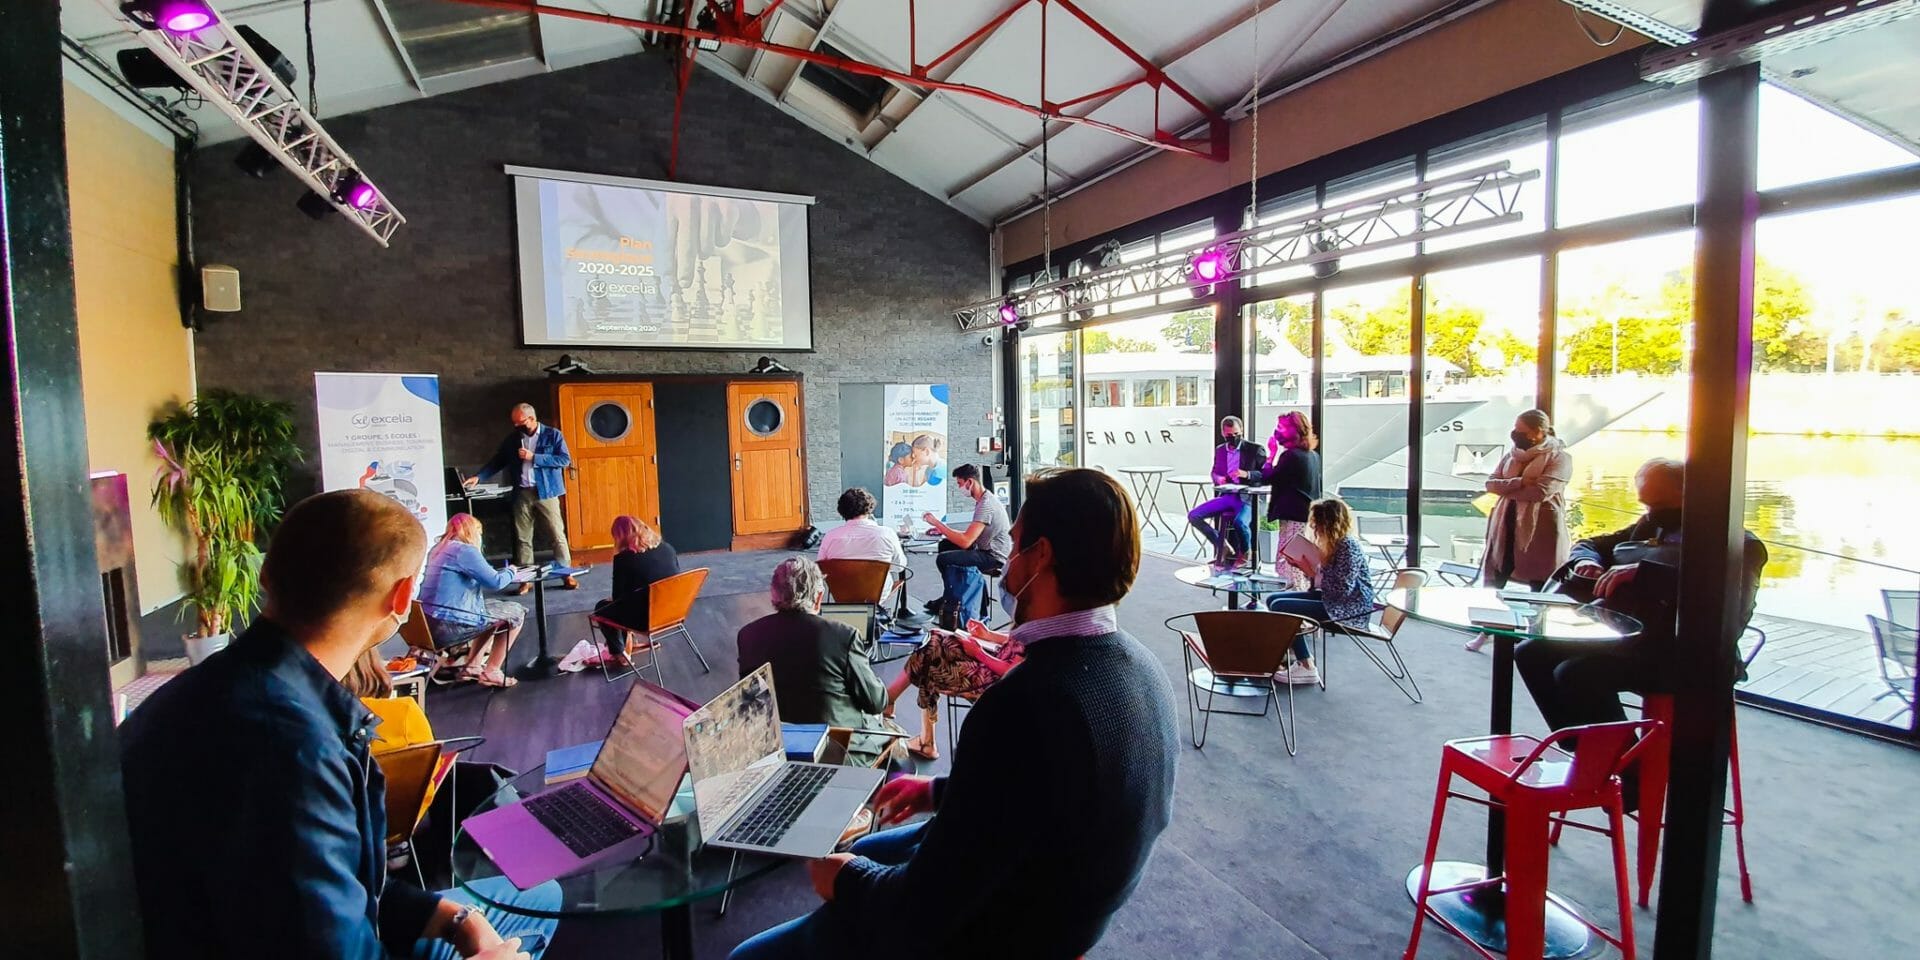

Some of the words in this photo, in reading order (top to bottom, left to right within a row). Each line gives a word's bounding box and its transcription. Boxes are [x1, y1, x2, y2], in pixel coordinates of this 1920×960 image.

[620, 237, 653, 249] Plan
[578, 262, 654, 276] 2020-2025
[609, 282, 656, 295] excelia
[371, 414, 412, 424] excelia
